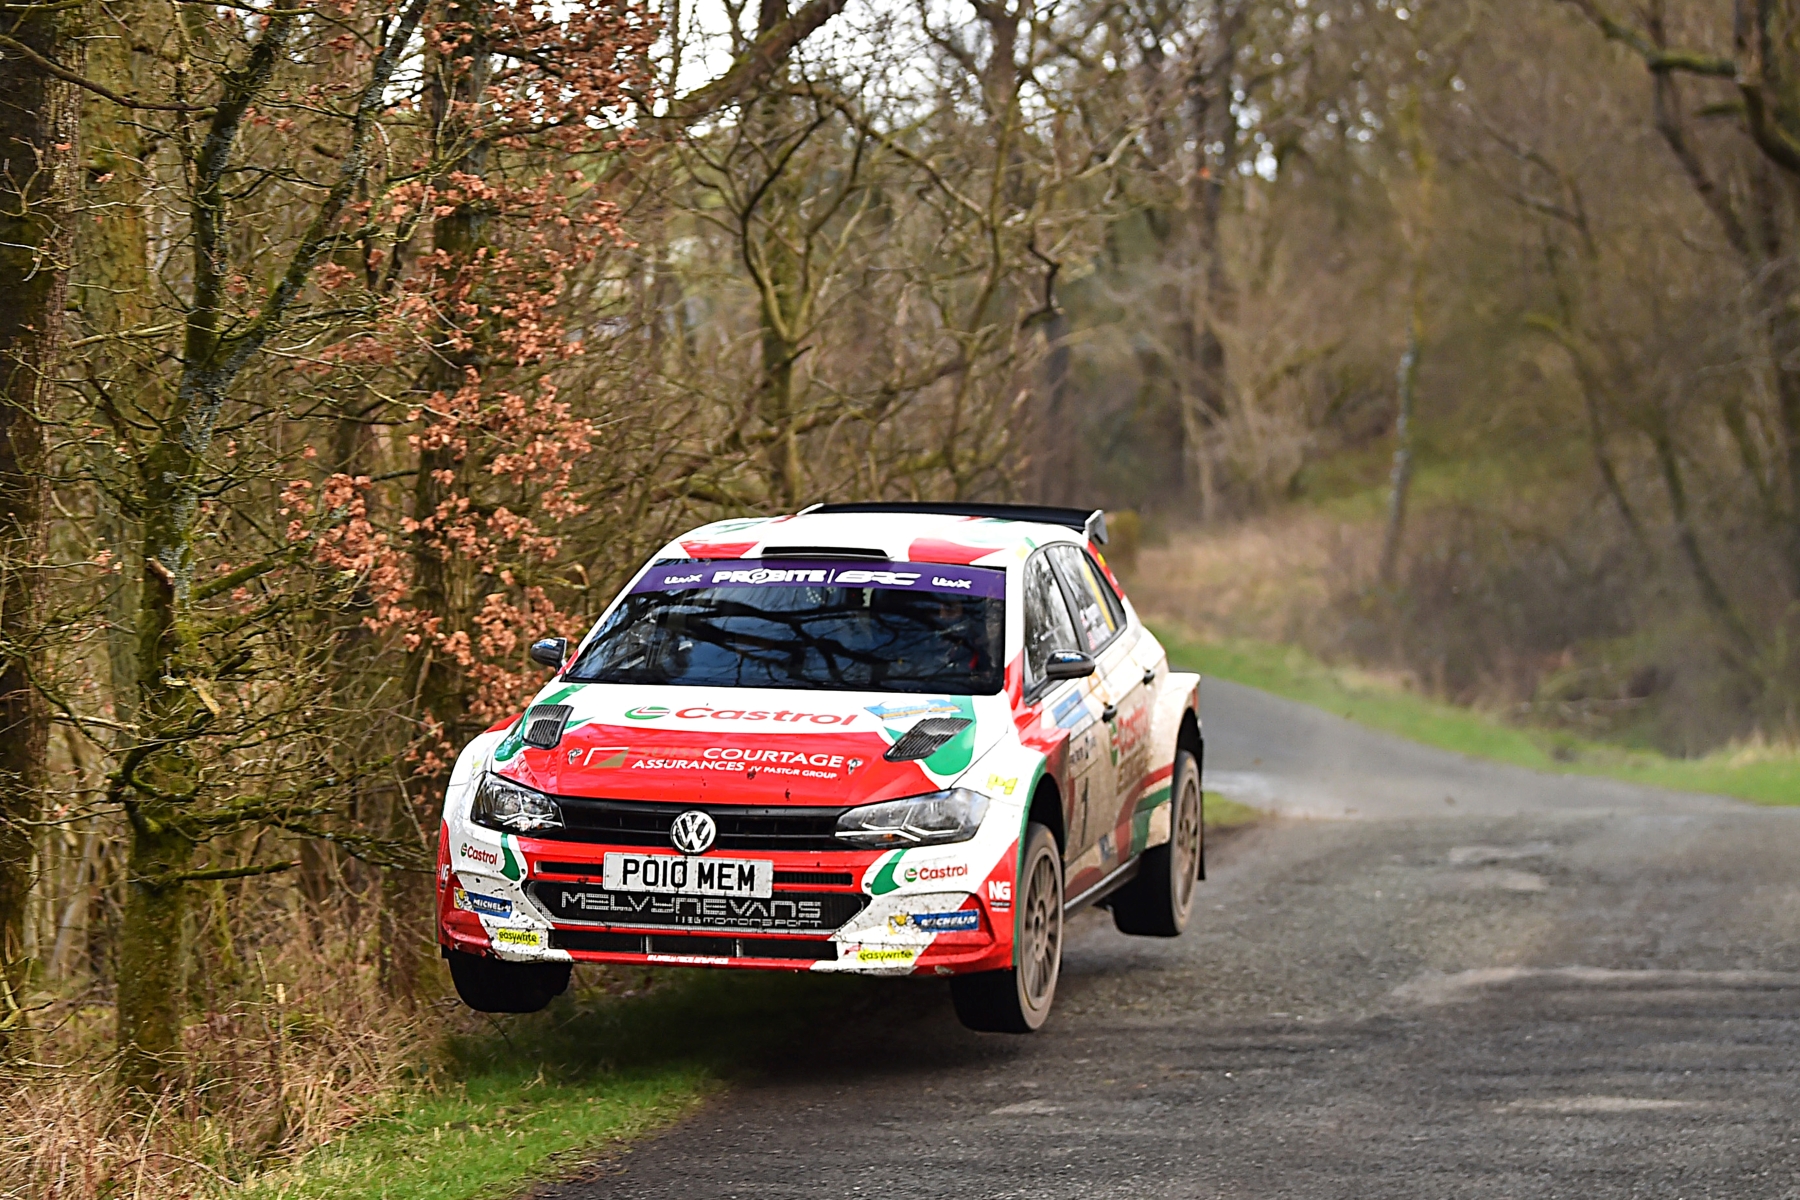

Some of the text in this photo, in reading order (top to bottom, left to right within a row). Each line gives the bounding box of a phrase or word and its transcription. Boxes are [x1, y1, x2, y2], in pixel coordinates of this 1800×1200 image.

[712, 568, 827, 584] PROBITE
[675, 707, 858, 725] Castrol
[631, 759, 745, 772] ASSURANCES
[763, 767, 800, 775] PASTOR
[802, 770, 837, 779] GROUP
[467, 846, 498, 865] Castrol
[622, 858, 755, 891] PO10 MEM
[919, 864, 968, 880] Castrol
[988, 881, 1011, 900] NG
[473, 898, 511, 912] MICHELN
